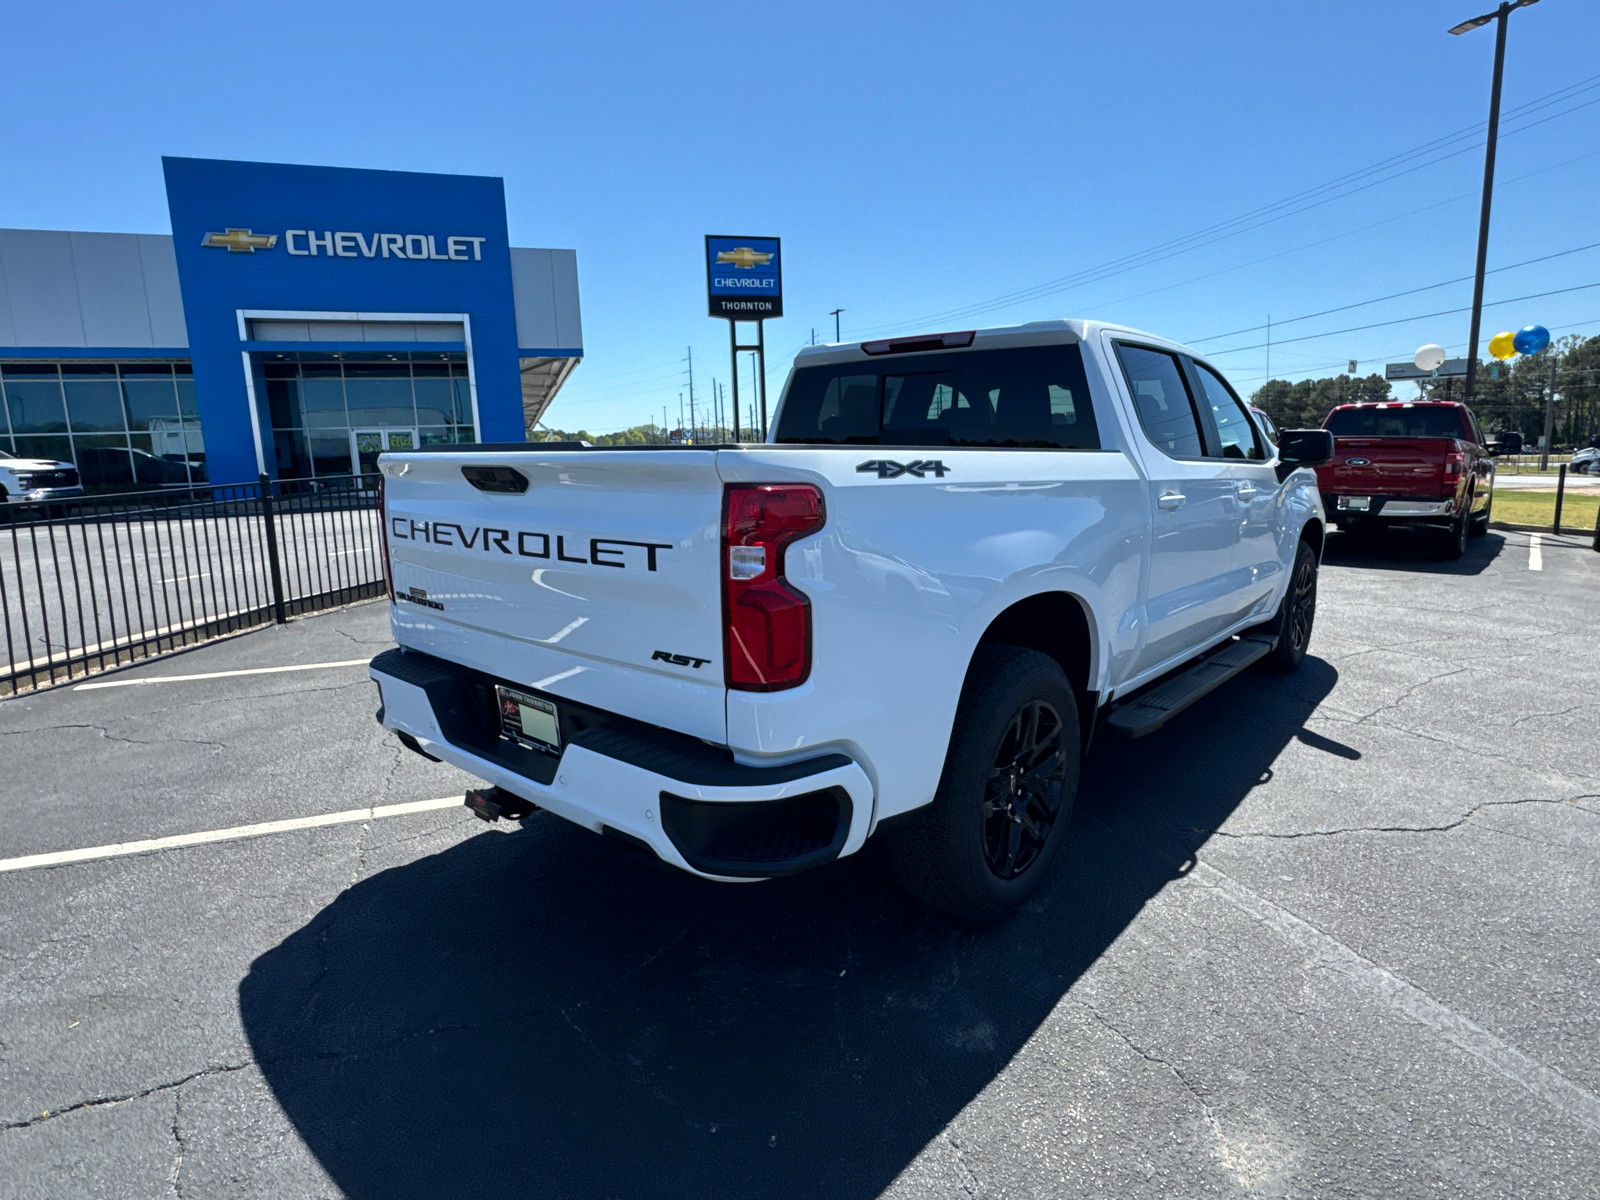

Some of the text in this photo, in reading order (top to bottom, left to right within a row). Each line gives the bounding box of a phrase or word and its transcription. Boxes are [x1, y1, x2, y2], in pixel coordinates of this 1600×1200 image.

[285, 229, 486, 261] CHEVROLET
[714, 278, 775, 288] CHEVROLET
[721, 301, 772, 310] THORNTON
[392, 517, 673, 572] CHEVROLET
[396, 591, 445, 611] SILVERADO
[651, 650, 711, 669] RST
